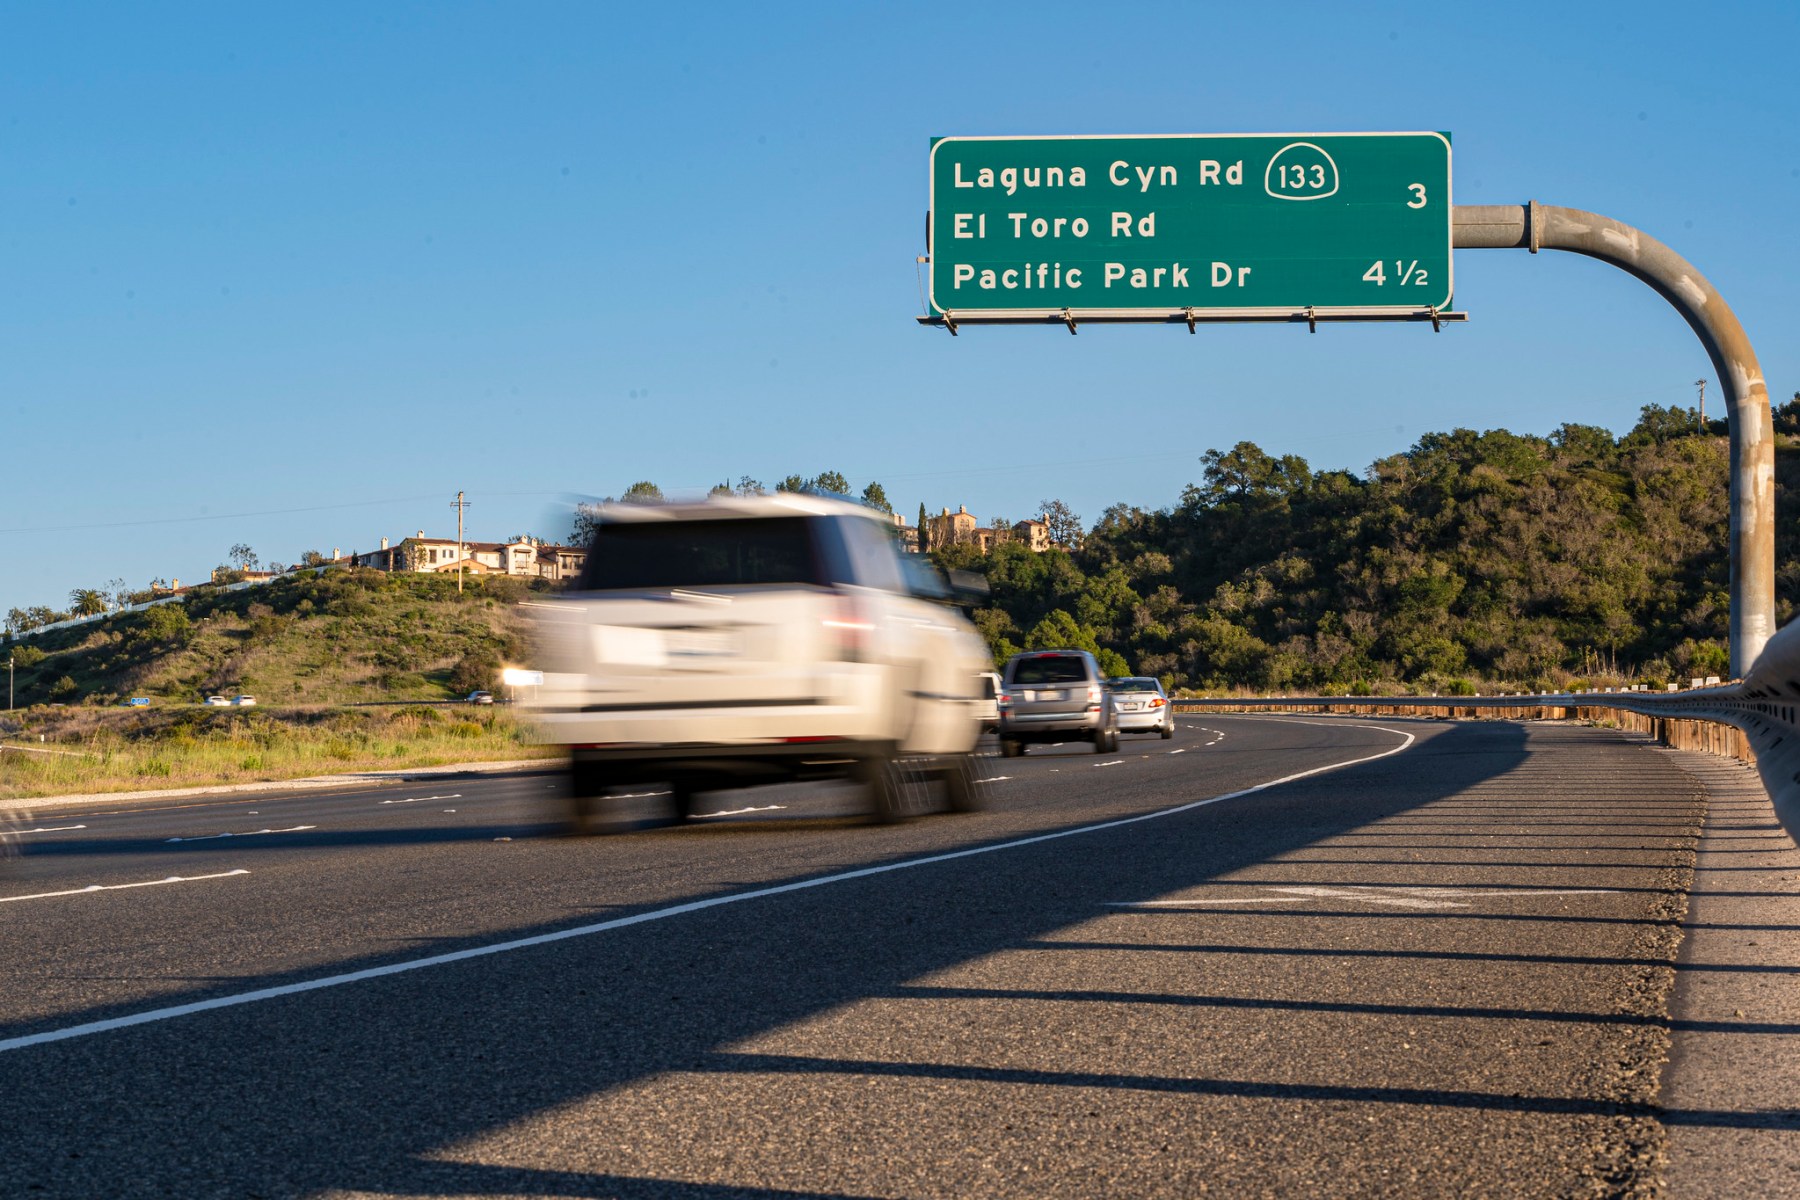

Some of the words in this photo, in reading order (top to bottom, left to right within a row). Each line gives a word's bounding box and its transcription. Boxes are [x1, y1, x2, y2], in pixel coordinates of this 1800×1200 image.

[954, 162, 1087, 196] Laguna
[1109, 160, 1178, 193] Cyn
[1199, 159, 1244, 186] Rd
[1279, 164, 1326, 189] 133
[1406, 183, 1428, 209] 3
[954, 213, 987, 239] El
[1007, 212, 1090, 238] Toro
[1111, 211, 1156, 238] Rd
[954, 262, 1083, 290] Pacific
[1104, 262, 1190, 289] Park
[1211, 261, 1252, 288] Dr
[1362, 260, 1387, 286] 4
